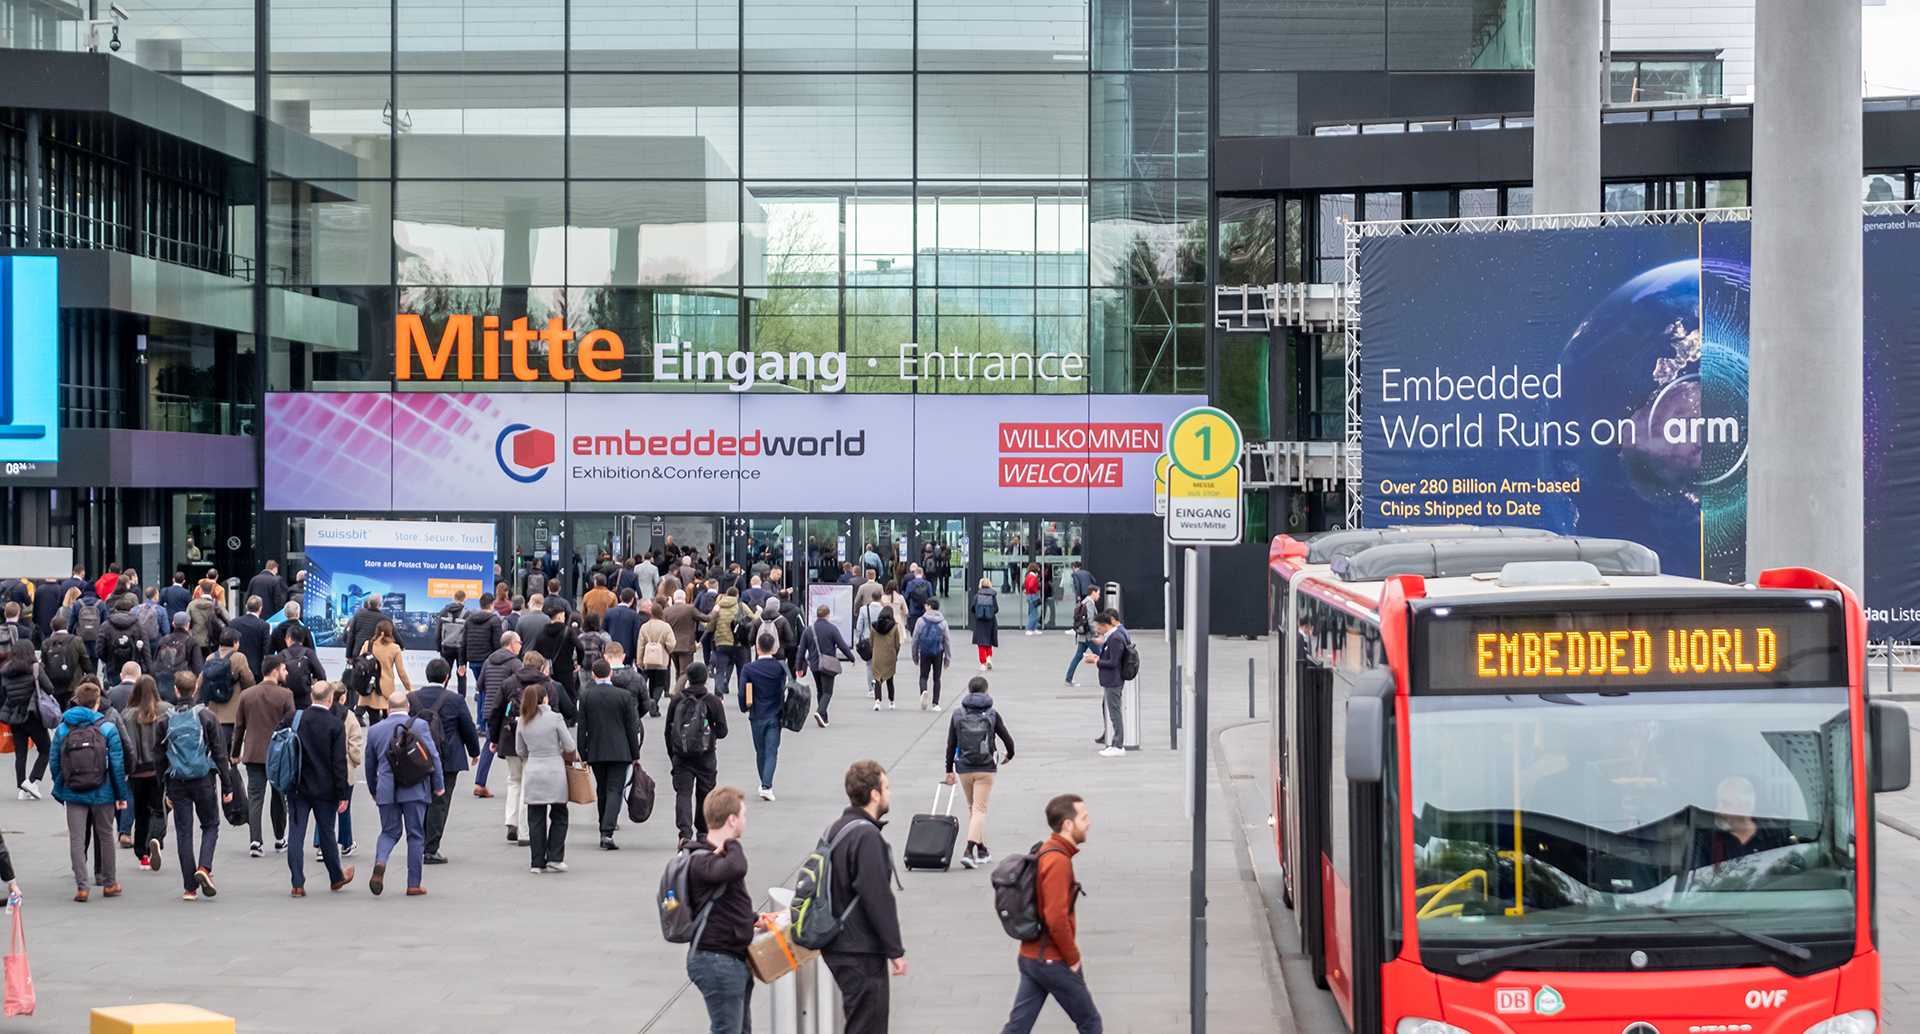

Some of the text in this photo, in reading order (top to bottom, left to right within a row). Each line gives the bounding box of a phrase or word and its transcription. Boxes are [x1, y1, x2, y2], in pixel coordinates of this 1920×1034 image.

[1864, 220, 1905, 232] generated
[396, 314, 625, 381] Mitte
[653, 342, 847, 392] Eingang
[899, 343, 1083, 381] Entrance
[1382, 363, 1562, 401] Embedded
[1003, 429, 1159, 449] WILLKOMMEN
[1380, 413, 1738, 448] World Runs on arm
[573, 429, 865, 456] embeddedworld
[1194, 426, 1211, 461] 1
[573, 466, 761, 479] Exhibition&Conference
[1004, 463, 1118, 483] WELCOME
[1380, 478, 1580, 494] Over 280 Billion Arm-based
[1176, 508, 1231, 518] EINGANG
[1380, 501, 1541, 518] Chips Shipped to Date
[1180, 521, 1226, 529] West/Mitte
[395, 532, 487, 544] Store. Secure. Trust.
[364, 559, 382, 567] Store
[439, 562, 455, 570] Data
[456, 563, 484, 572] Reliably
[1891, 607, 1920, 621] Liste
[1478, 628, 1777, 676] EMBEDDED WORLD
[1501, 992, 1525, 1009] DB
[1744, 989, 1789, 1009] OVF
